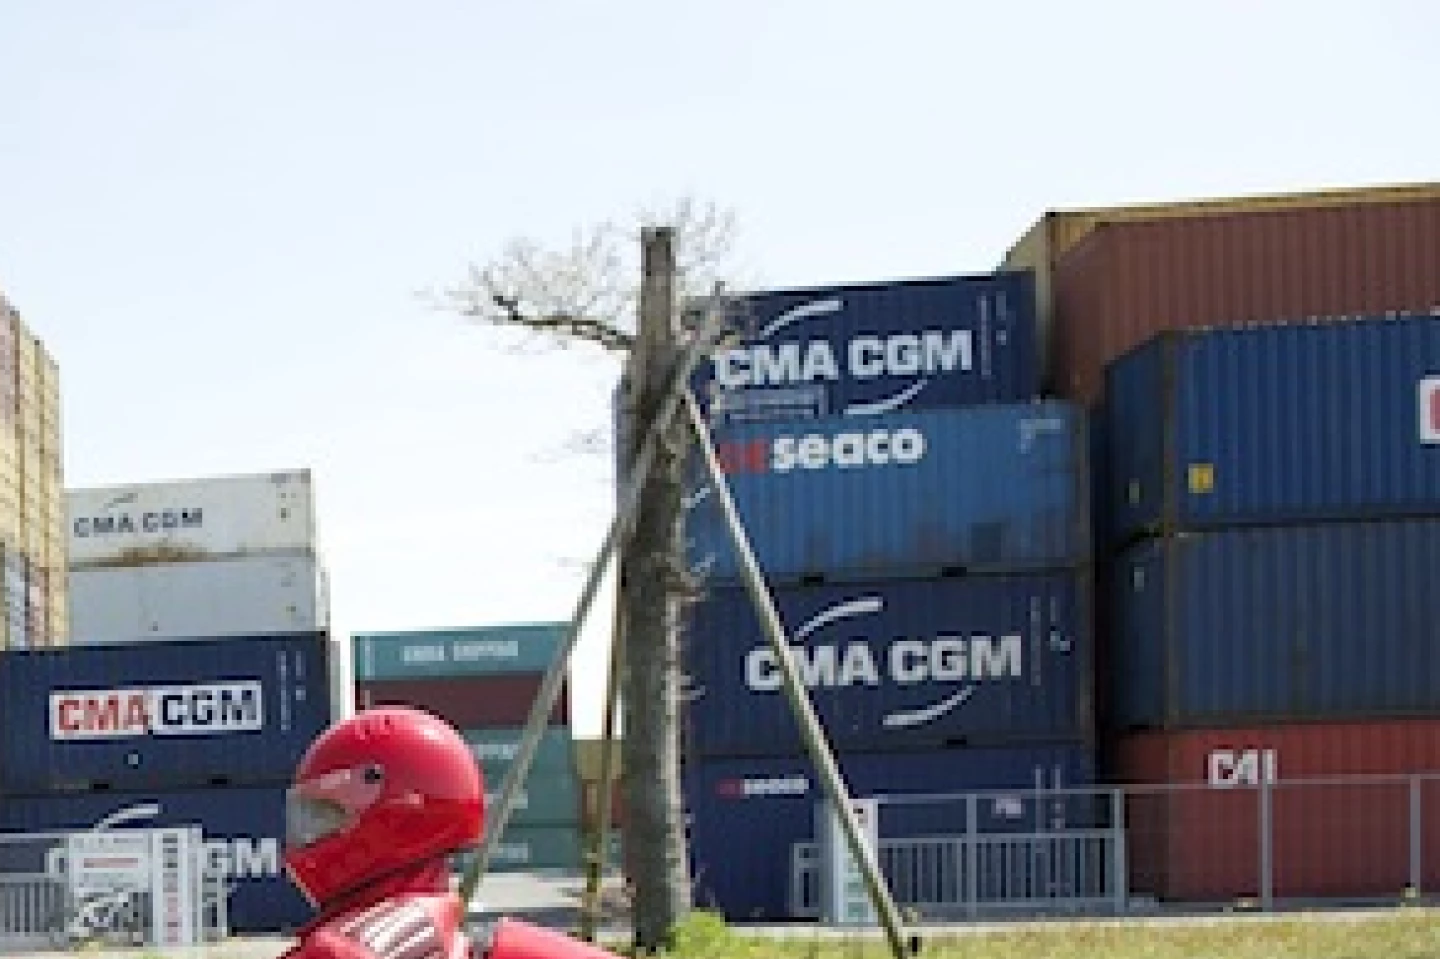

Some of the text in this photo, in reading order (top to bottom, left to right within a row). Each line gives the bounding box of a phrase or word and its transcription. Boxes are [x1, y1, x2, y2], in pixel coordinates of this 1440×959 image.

[715, 340, 838, 387] CMA
[849, 332, 972, 376] CGM
[773, 428, 926, 473] seaco
[73, 507, 203, 538] CMA CGM
[744, 645, 878, 692] CMA
[889, 635, 1022, 681] CGM
[58, 694, 150, 731] CMA
[162, 688, 258, 726] CGM
